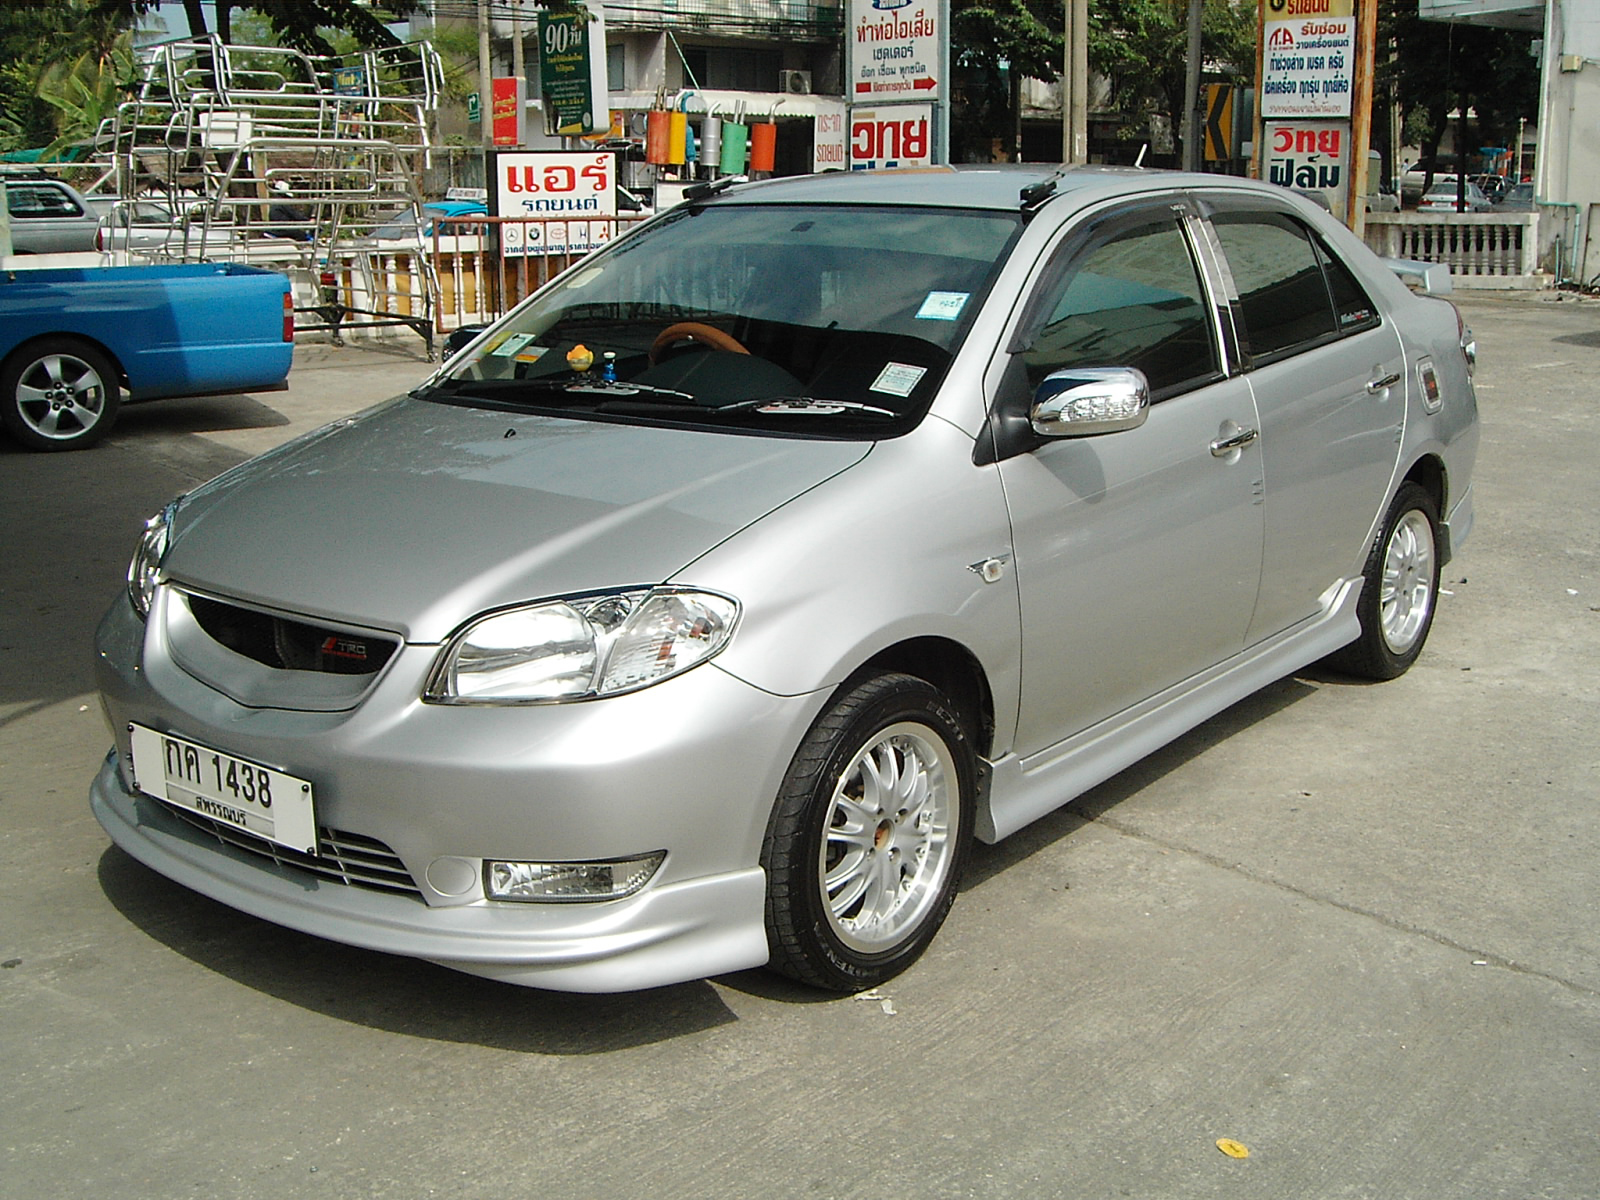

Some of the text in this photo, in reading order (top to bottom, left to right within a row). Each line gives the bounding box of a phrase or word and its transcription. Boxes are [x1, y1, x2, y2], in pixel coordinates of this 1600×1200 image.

[545, 22, 568, 54] 90
[856, 9, 934, 42] ทำท่อไอเสีย
[1273, 127, 1340, 158] วิทยุ
[507, 154, 609, 193] แอร์
[1270, 155, 1340, 189] ฟิล์ม
[521, 193, 598, 212] รถยนต์
[212, 754, 272, 809] 1438
